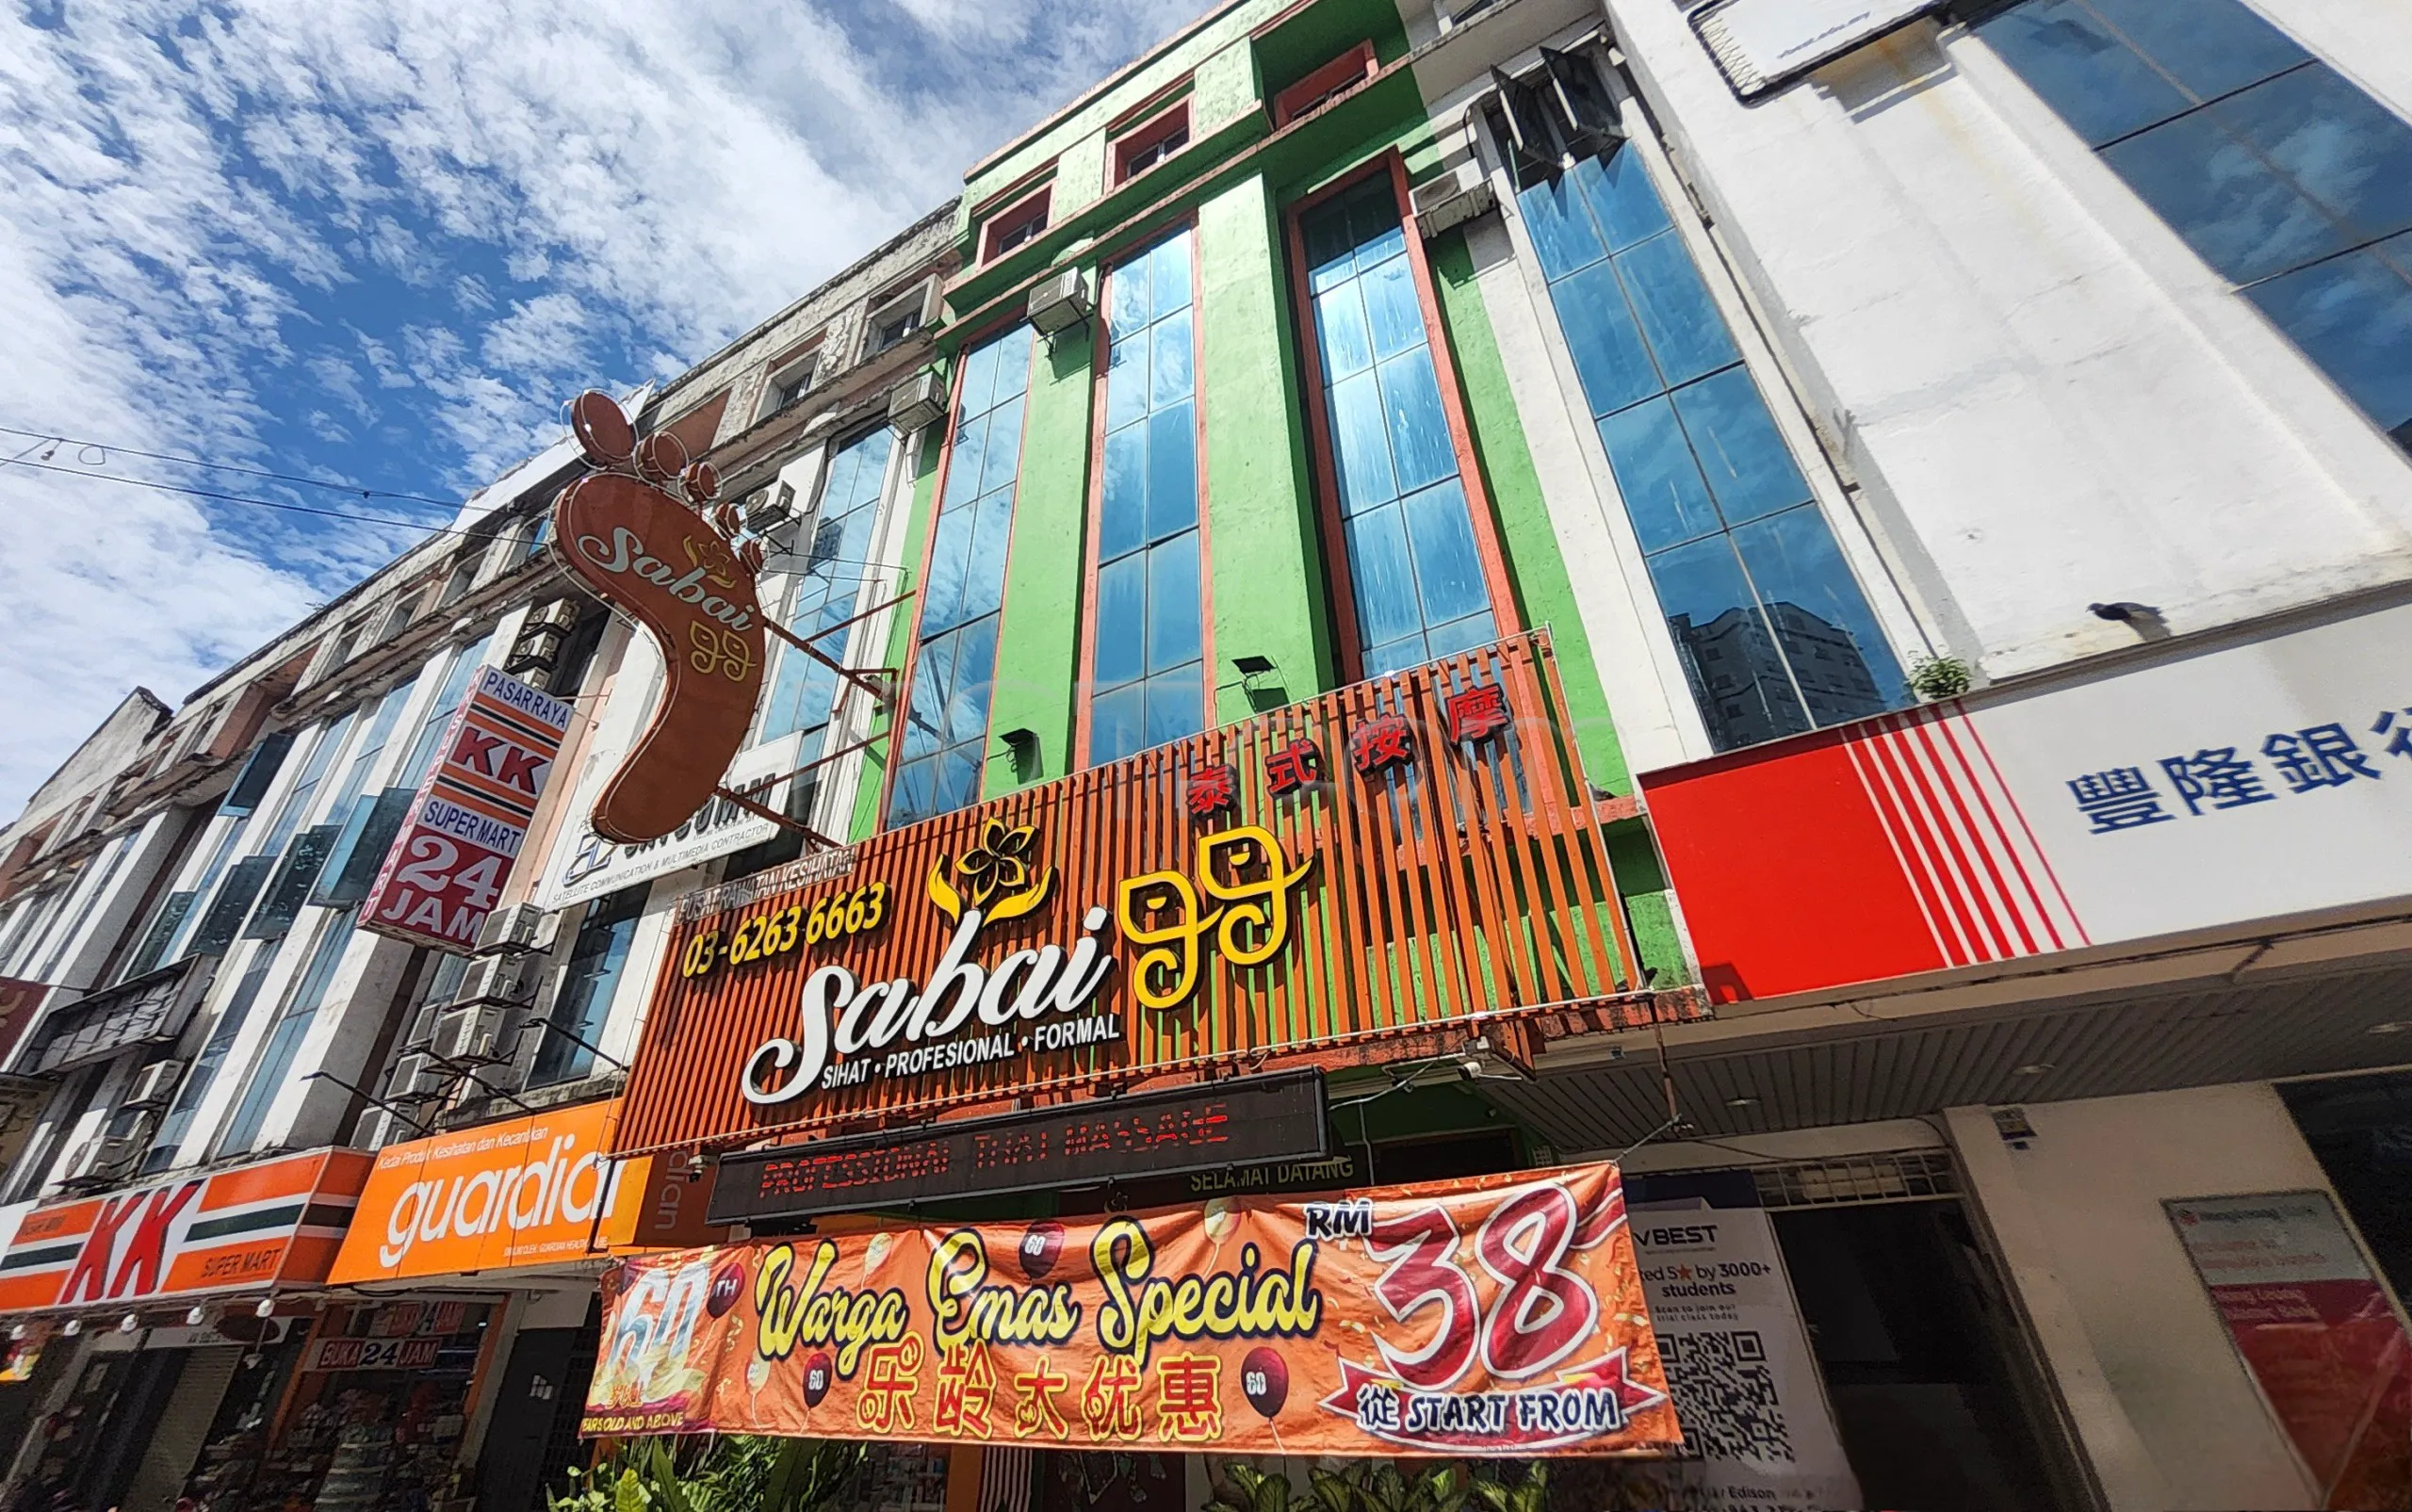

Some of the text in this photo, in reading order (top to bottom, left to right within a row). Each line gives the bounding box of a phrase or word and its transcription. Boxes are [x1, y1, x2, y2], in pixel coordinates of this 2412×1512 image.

[578, 527, 753, 631] Sabai
[449, 726, 550, 794] KK
[1184, 685, 1510, 815] 泰式按摩
[477, 822, 521, 854] MART
[660, 840, 709, 868] MULTIMEDIA
[710, 822, 770, 849] CONTRACTOR
[396, 835, 503, 910] 24
[381, 888, 485, 943] JAM
[806, 882, 886, 945] 6663
[741, 906, 1112, 1105] Sabai
[822, 1013, 1120, 1091] SIHAT PROFESIONAL FORMAL
[477, 1137, 496, 1151] dan
[60, 1179, 207, 1306] KK
[202, 1248, 284, 1278] SUPER MART
[1024, 1234, 1046, 1256] 60
[713, 1278, 739, 1298] TH
[1305, 1183, 1600, 1390] RM 38
[1661, 1281, 1737, 1298] students
[1696, 1264, 1717, 1282] by
[1718, 1261, 1772, 1278] 3000+
[754, 1214, 1321, 1381] Warga Emas Special
[320, 1341, 438, 1366] BUKA 24 JAM
[809, 1368, 825, 1391] 60
[1246, 1370, 1267, 1396] 60
[603, 1416, 625, 1432] OLD
[624, 1416, 645, 1430] AND
[645, 1411, 685, 1429] ABOVE
[1407, 1390, 1508, 1435] START
[1516, 1388, 1622, 1433] FROM
